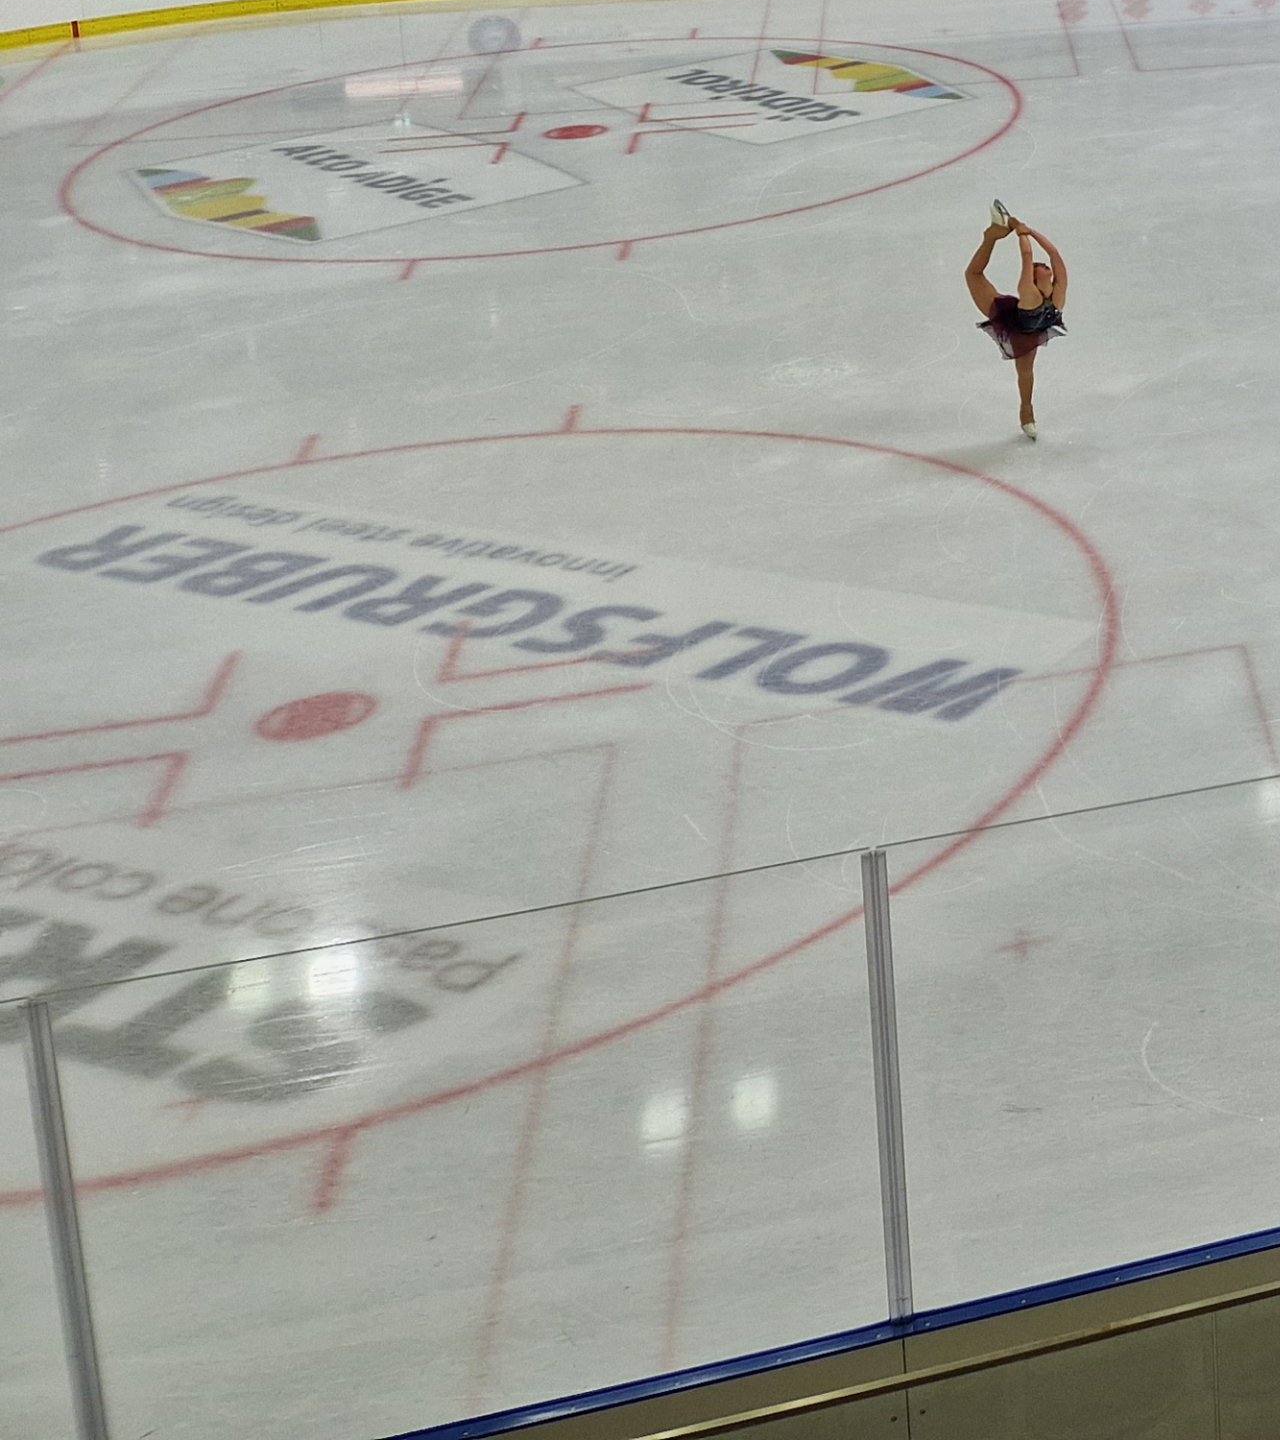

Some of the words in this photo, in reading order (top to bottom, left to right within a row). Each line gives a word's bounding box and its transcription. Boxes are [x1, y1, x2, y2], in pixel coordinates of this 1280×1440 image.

[165, 492, 302, 535] design
[304, 514, 407, 550] steel
[407, 529, 638, 583] innovative
[39, 522, 1023, 721] WOLFSGRUBER
